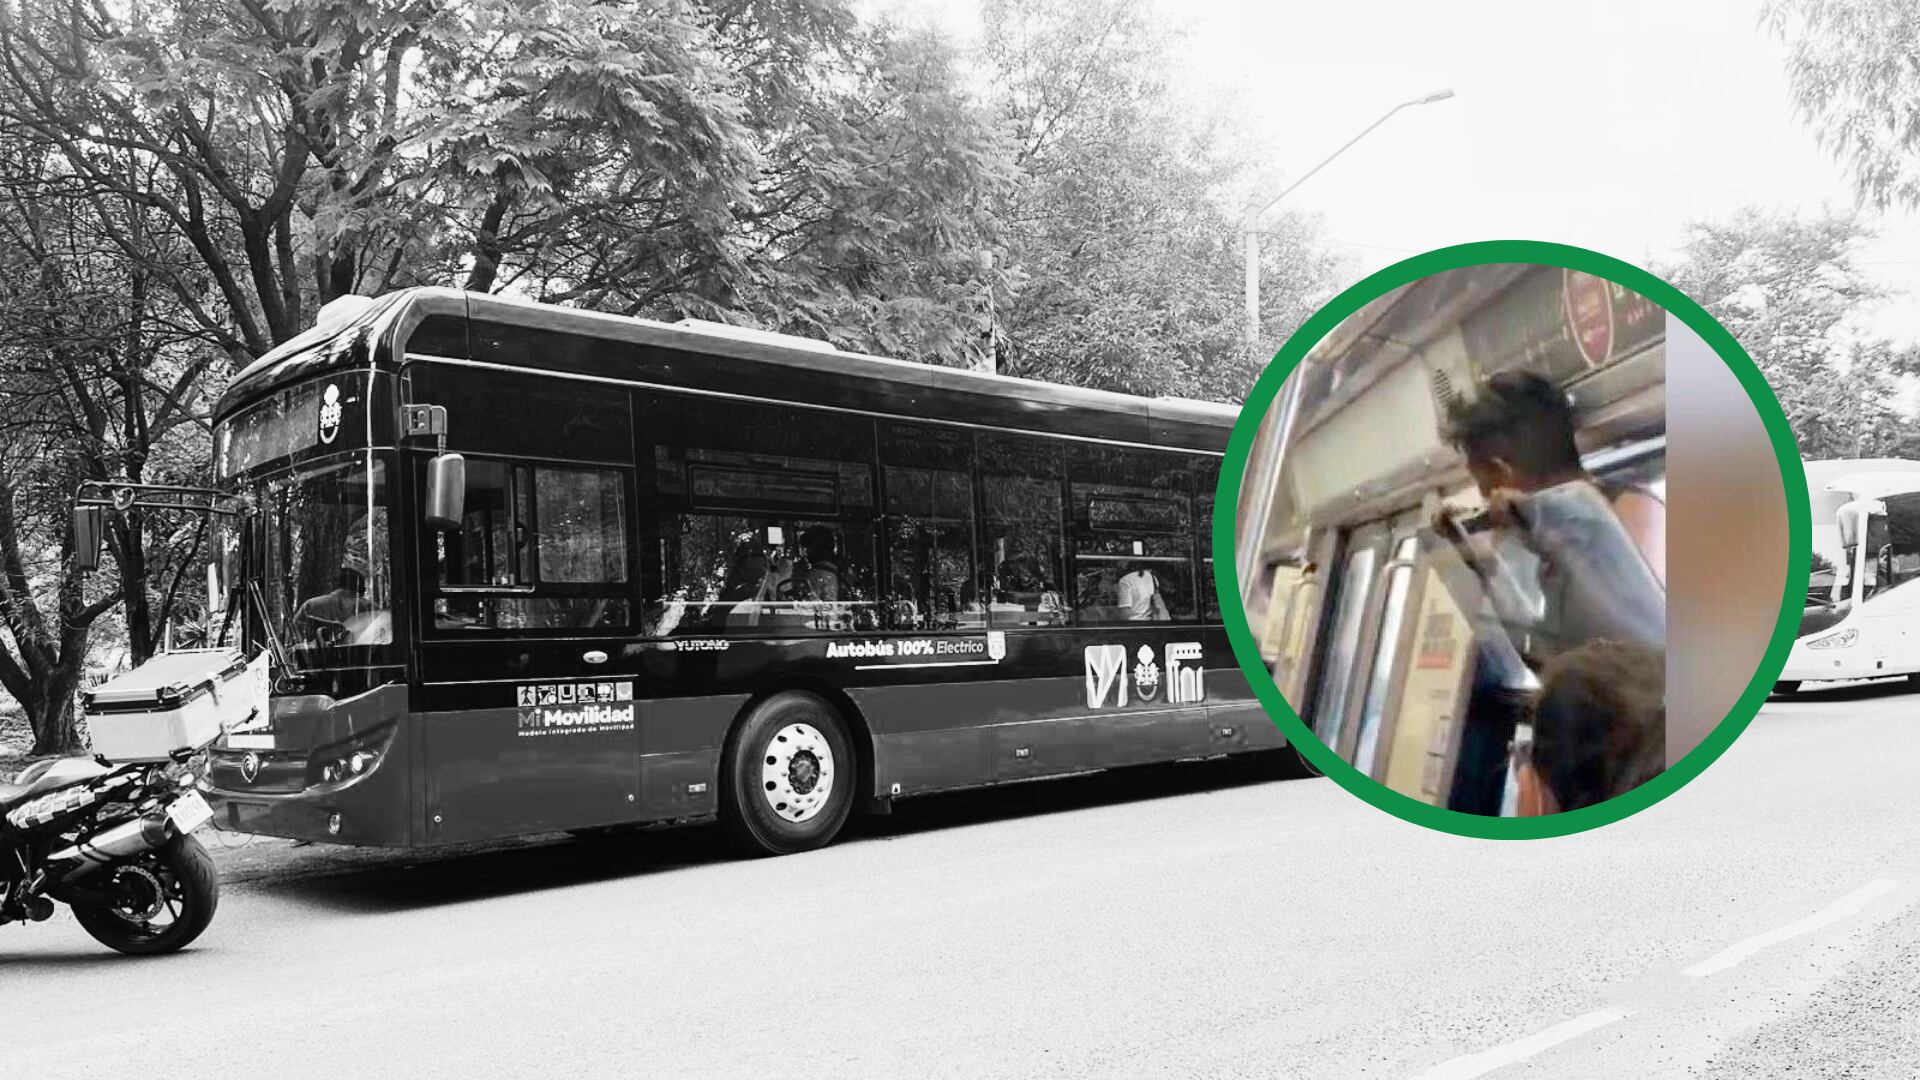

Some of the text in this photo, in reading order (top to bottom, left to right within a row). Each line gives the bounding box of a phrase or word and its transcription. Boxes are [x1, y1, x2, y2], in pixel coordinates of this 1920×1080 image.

[826, 640, 983, 658] Autobús 100% Electrico
[518, 704, 634, 727] Mi Movilidad
